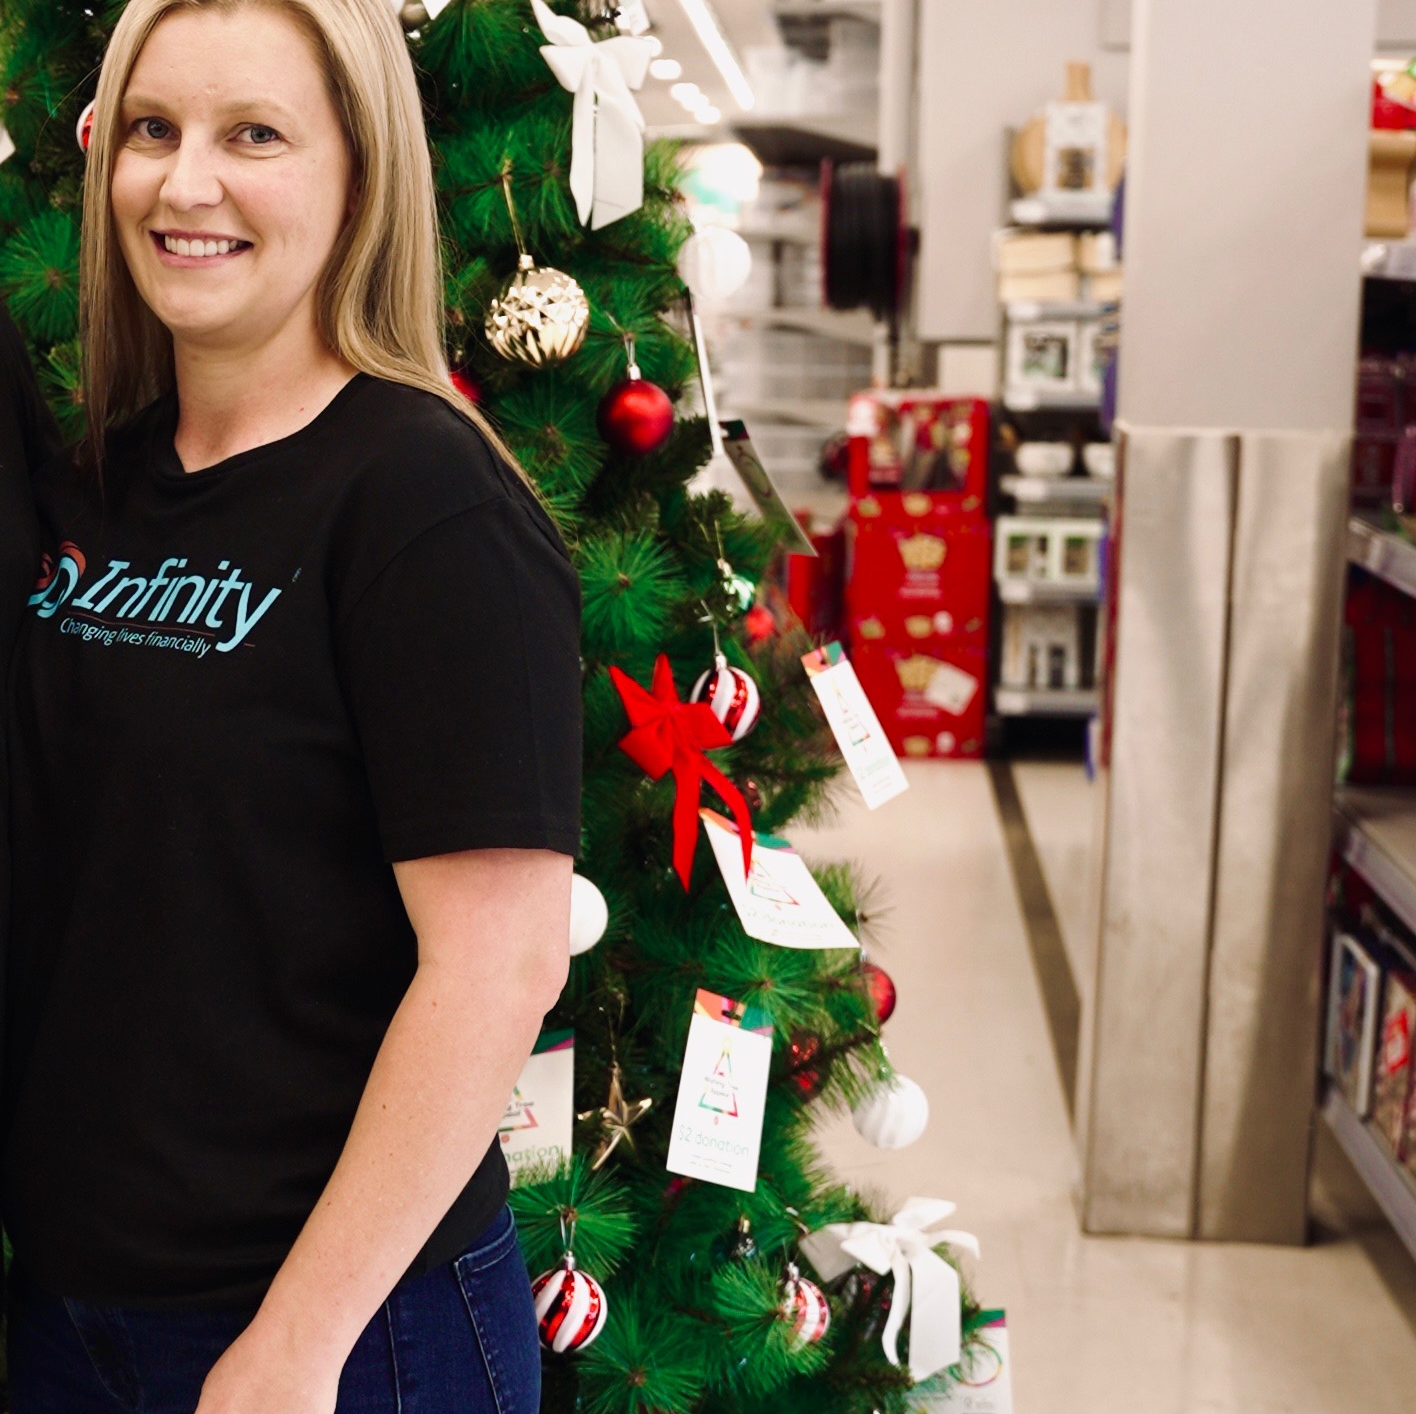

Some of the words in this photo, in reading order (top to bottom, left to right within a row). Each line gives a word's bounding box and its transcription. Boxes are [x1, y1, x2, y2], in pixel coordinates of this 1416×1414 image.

[59, 617, 117, 645] Changing
[117, 628, 144, 645] lives
[144, 630, 212, 658] financially
[71, 557, 282, 653] Infinity
